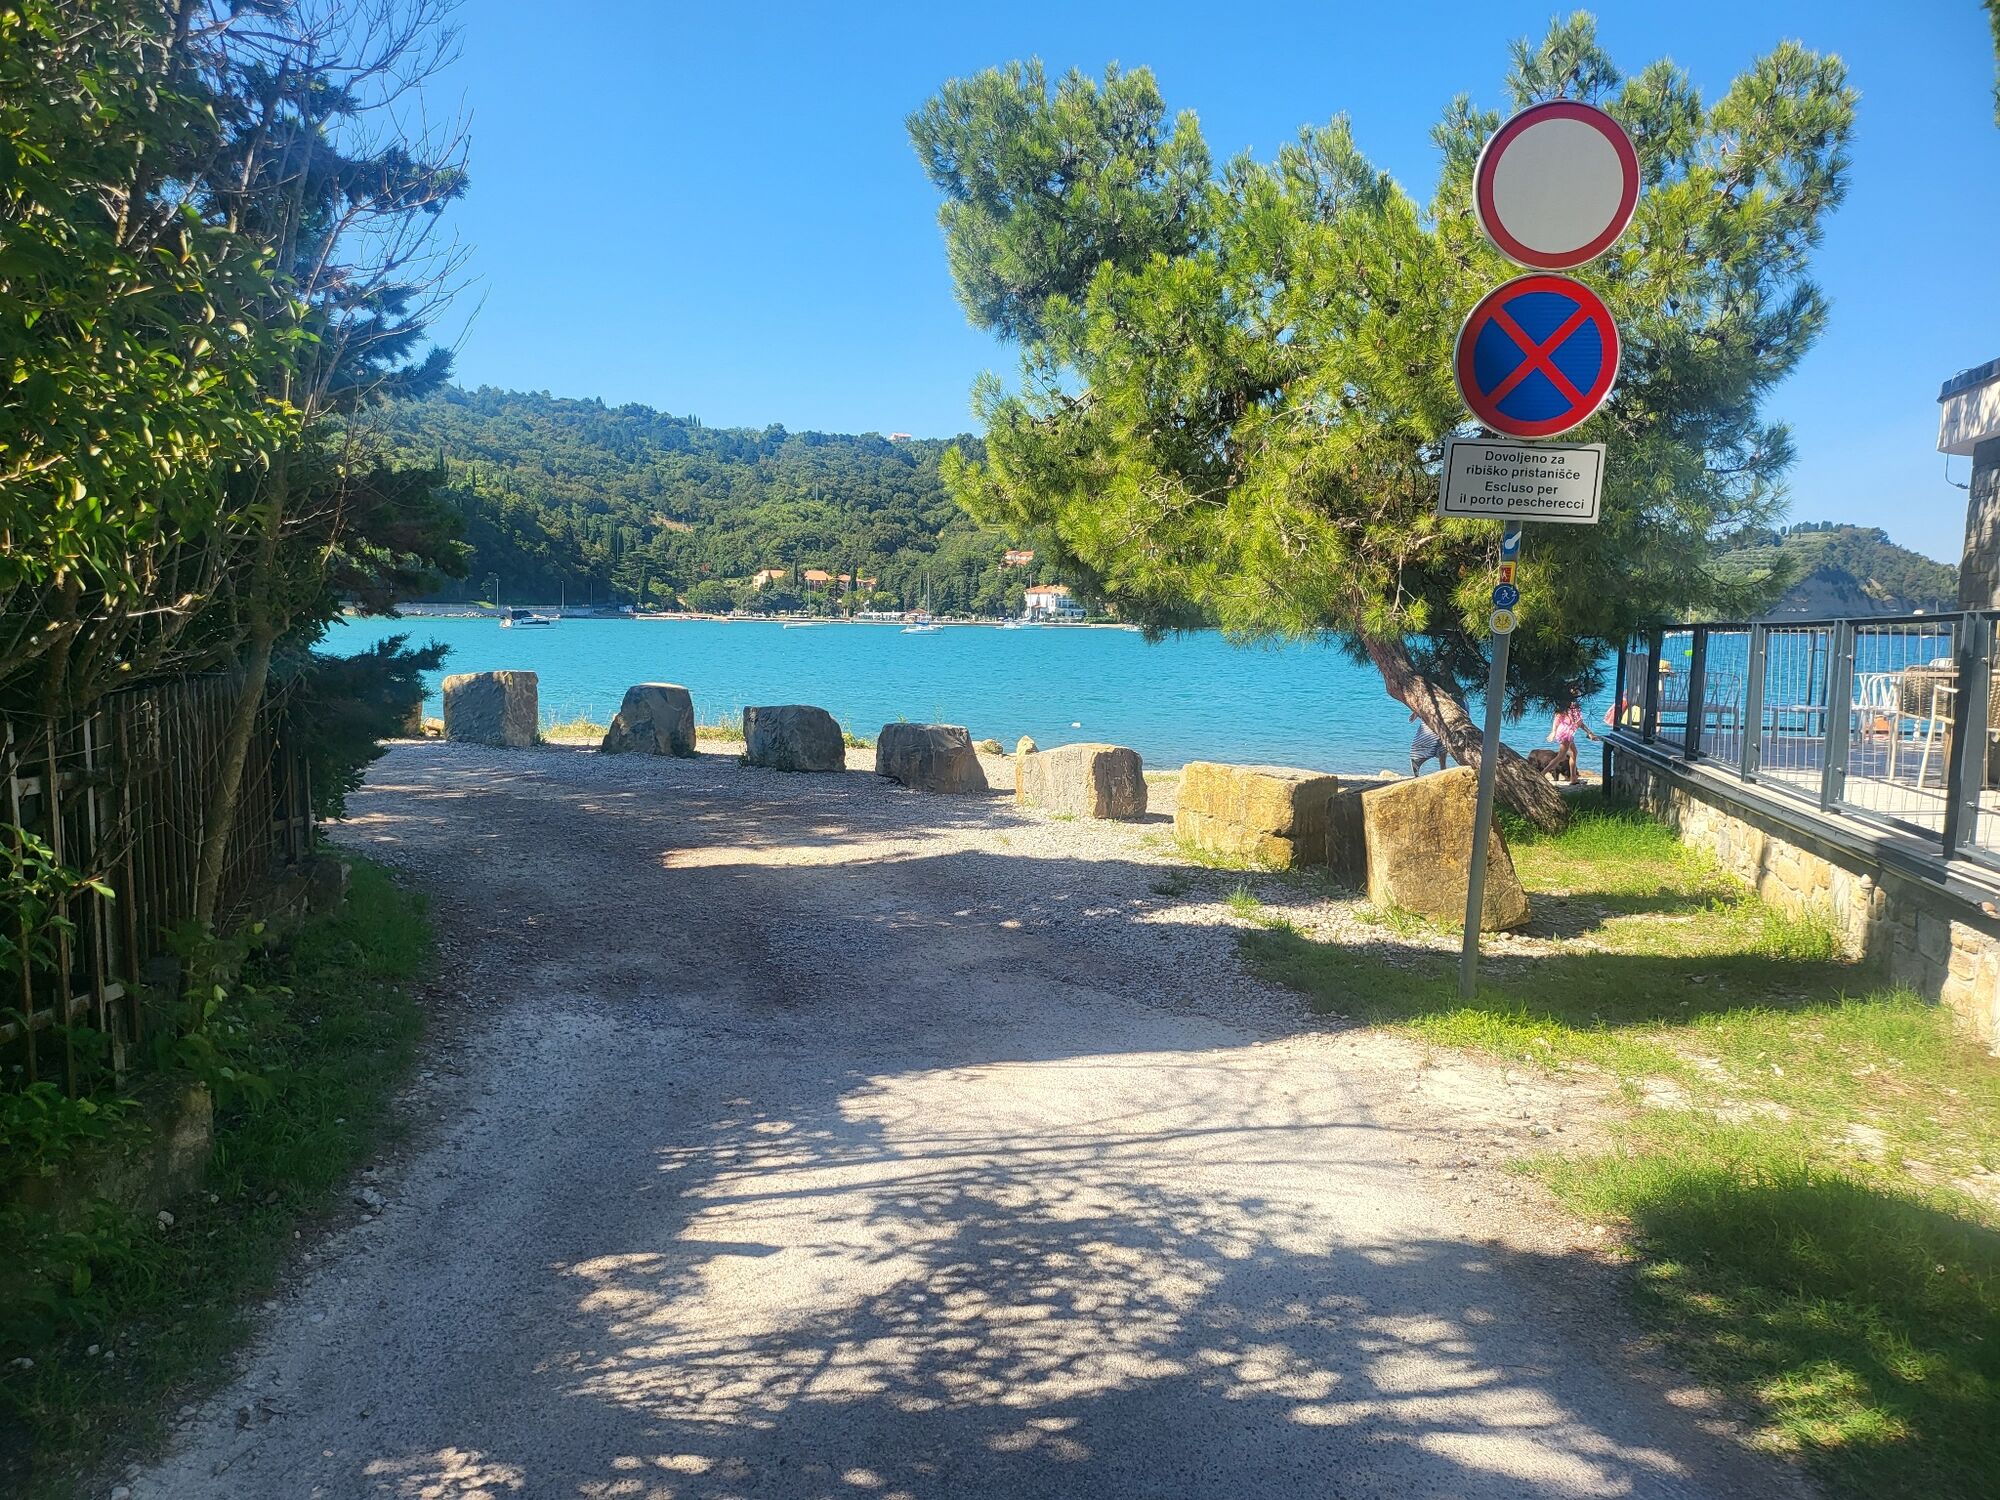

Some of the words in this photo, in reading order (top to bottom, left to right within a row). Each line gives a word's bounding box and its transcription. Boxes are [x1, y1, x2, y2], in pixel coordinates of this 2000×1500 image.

[1485, 451, 1547, 464] Dovoljeno
[1550, 456, 1565, 465] za
[1466, 466, 1508, 476] ribiško
[1511, 468, 1581, 480] pristanišče
[1485, 481, 1534, 493] Escluso
[1537, 486, 1559, 495] per
[1459, 493, 1467, 503] il
[1470, 495, 1504, 506] porto
[1507, 497, 1585, 509] pescherecci
